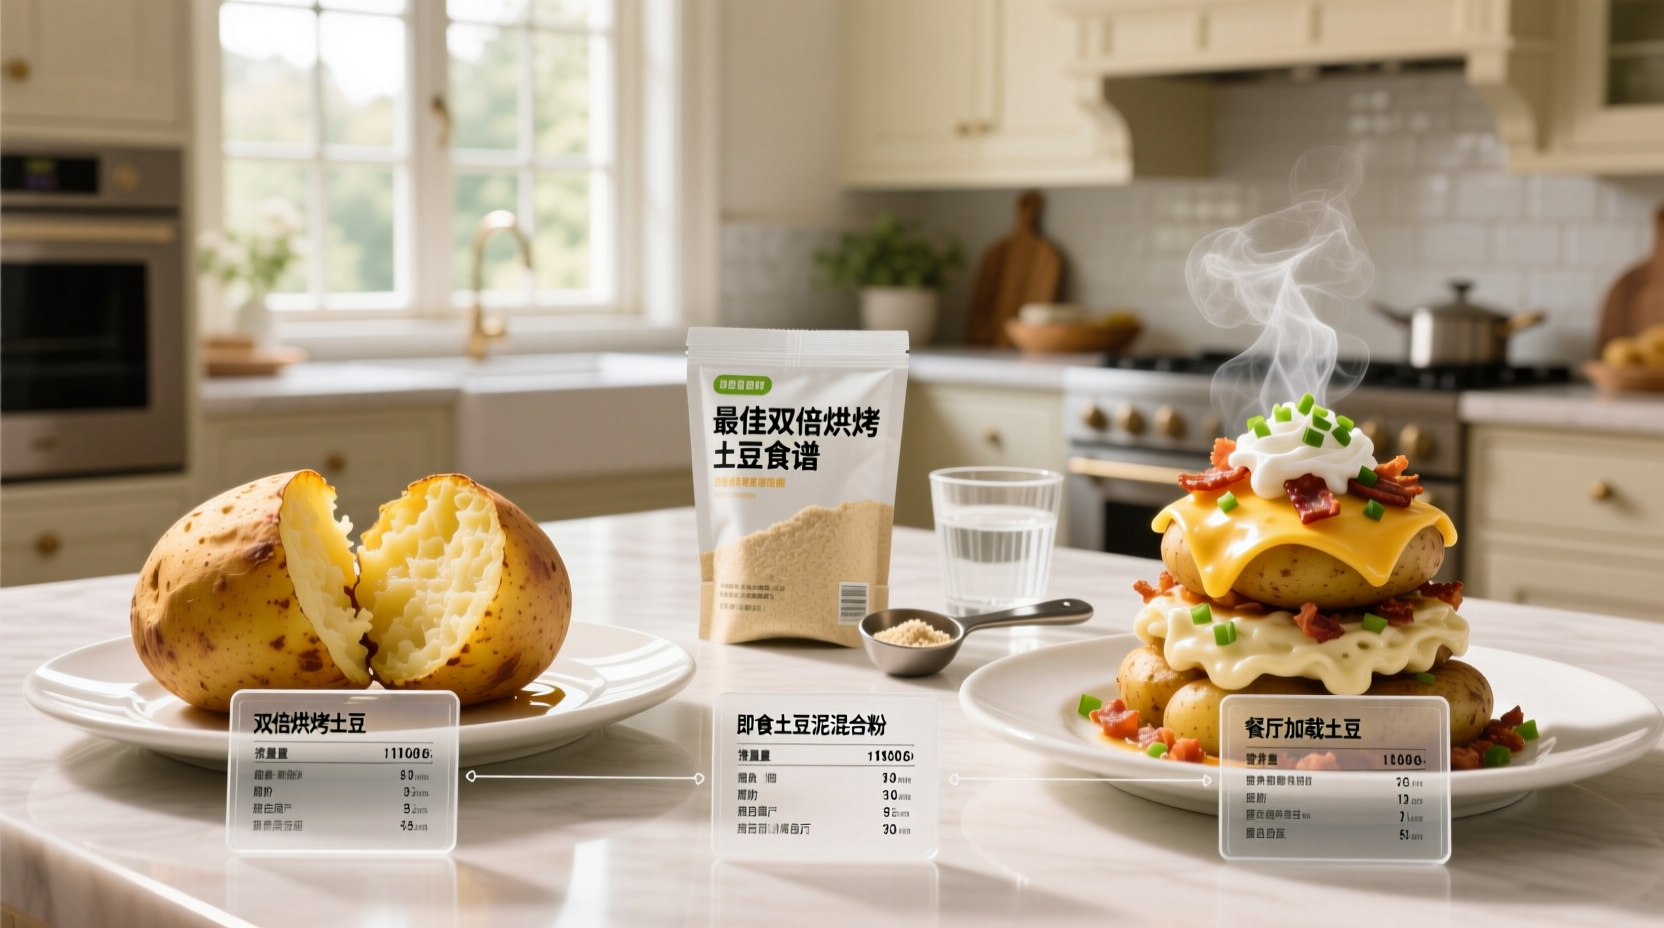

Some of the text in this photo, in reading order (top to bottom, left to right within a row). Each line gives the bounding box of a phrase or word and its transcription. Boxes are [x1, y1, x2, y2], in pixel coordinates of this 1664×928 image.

[713, 406, 880, 437] 最佳双倍烘烤
[713, 440, 820, 471] 土豆食谱
